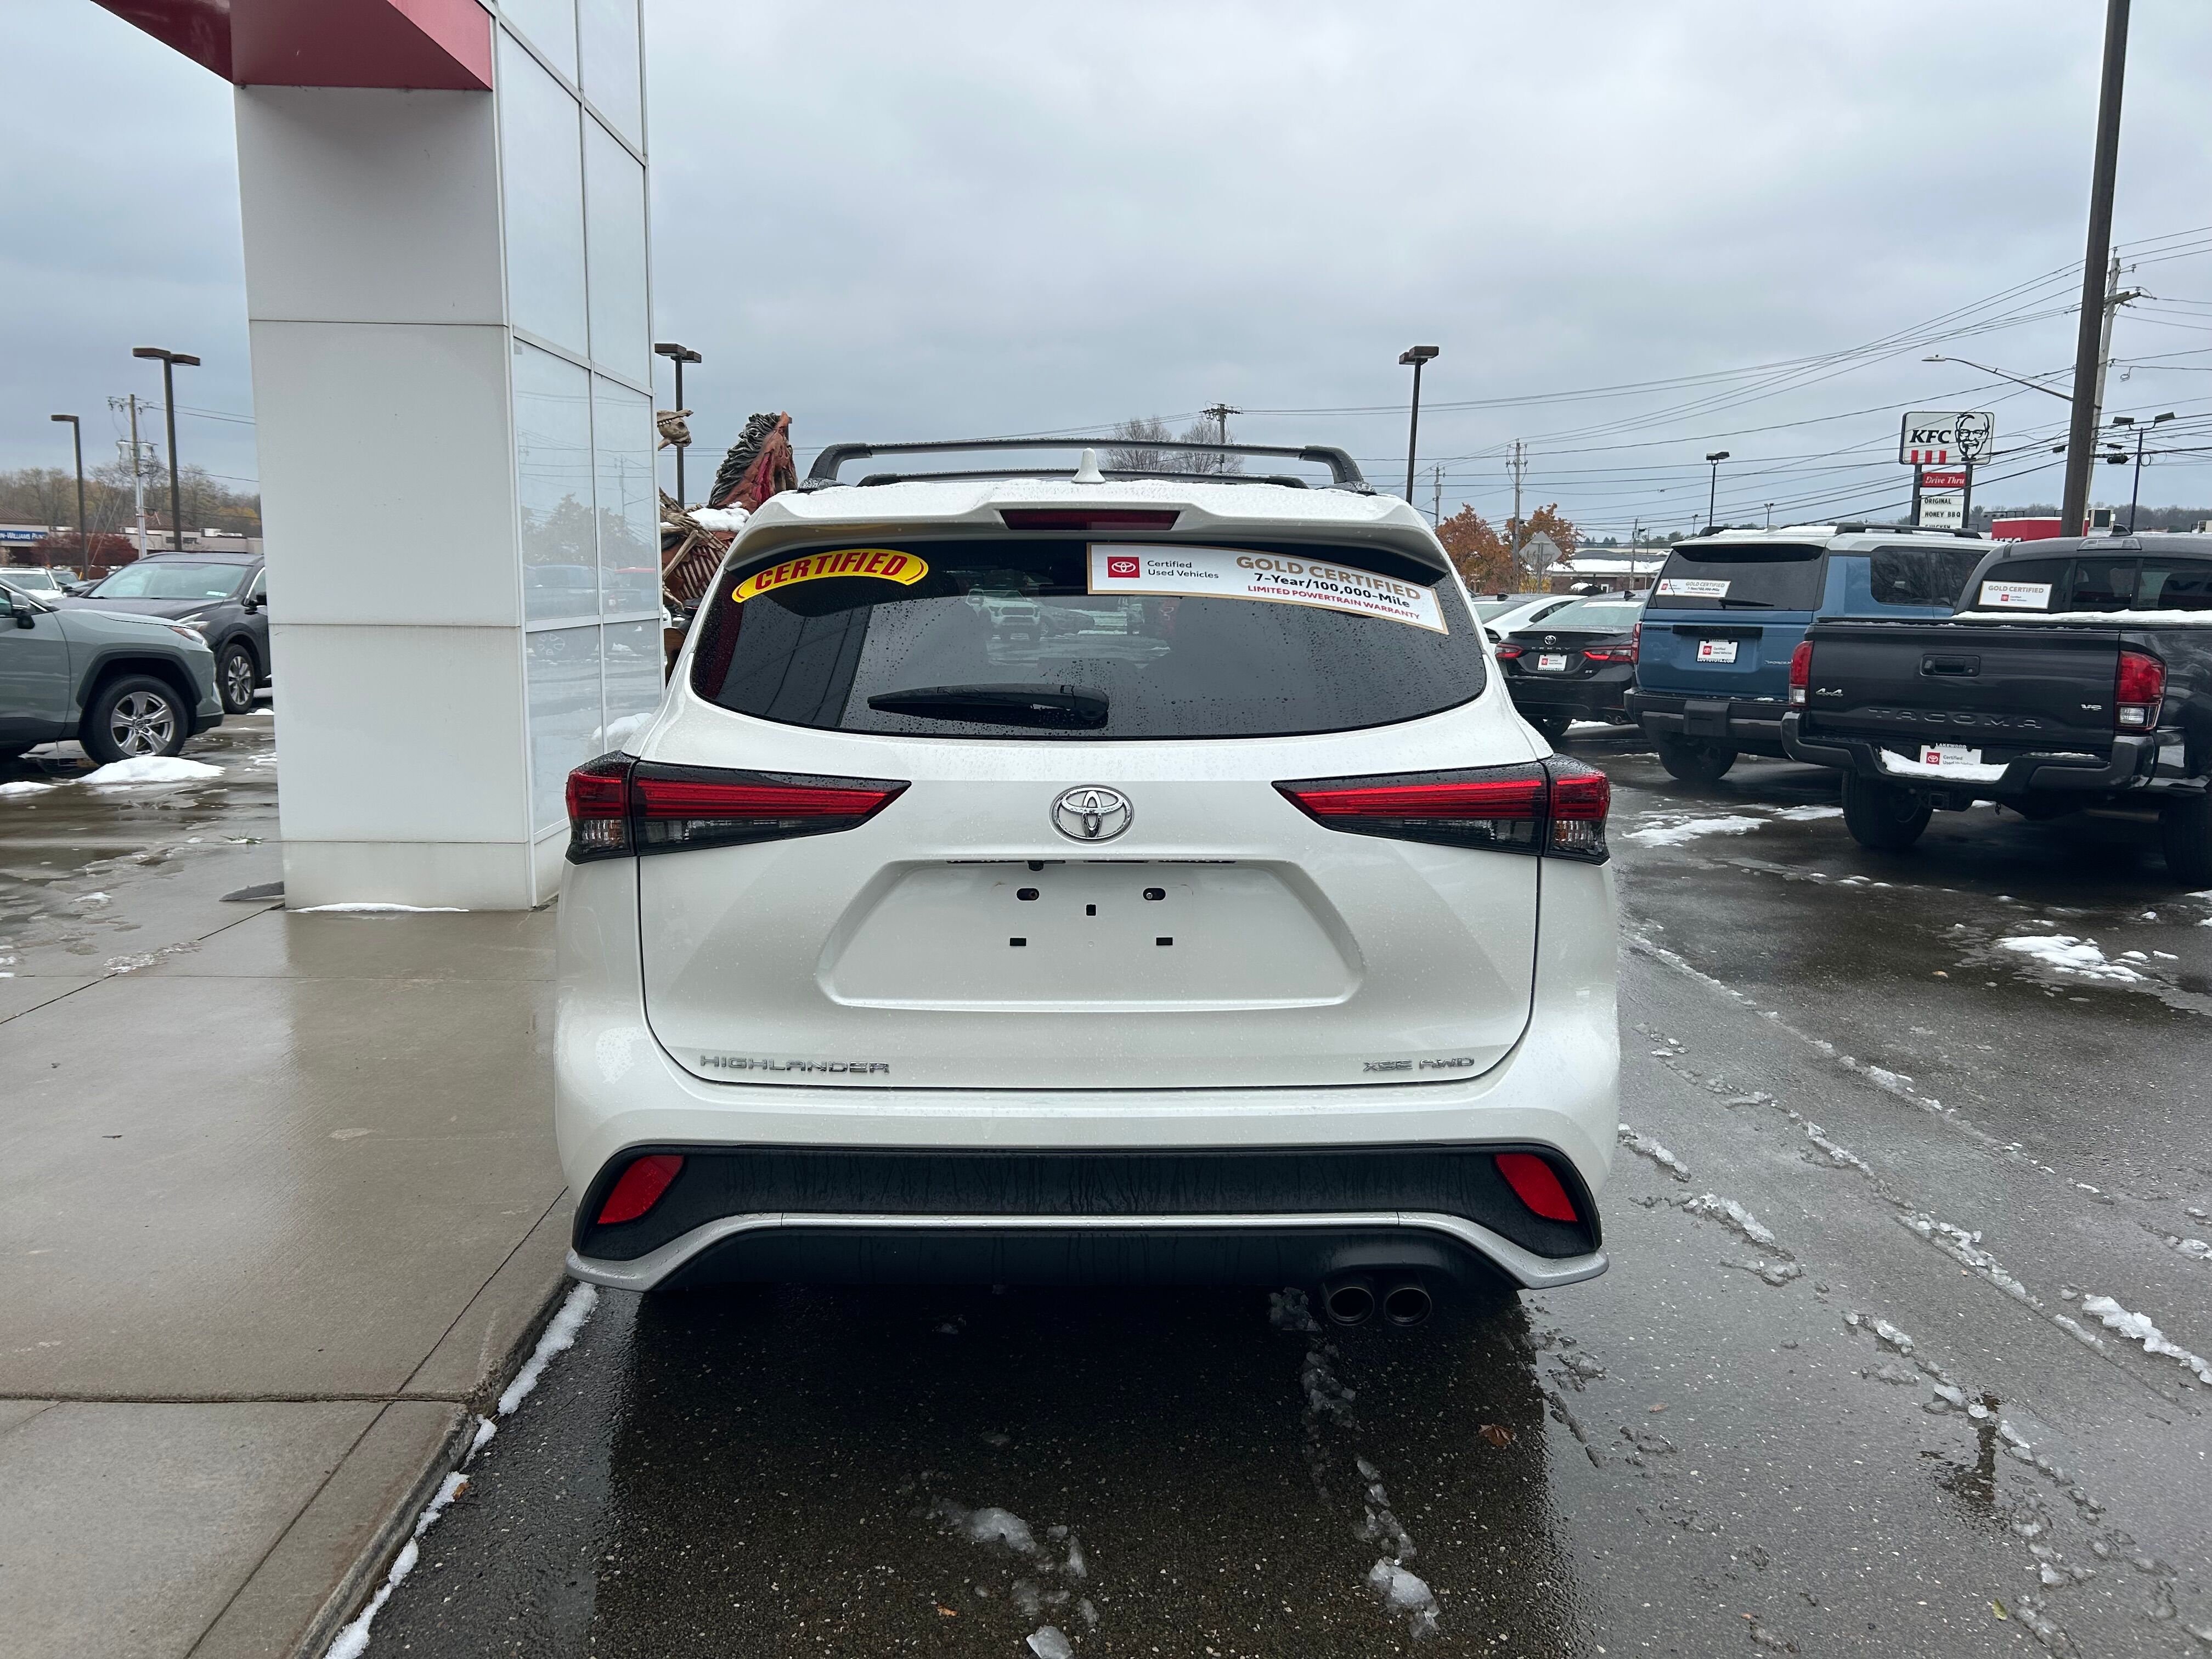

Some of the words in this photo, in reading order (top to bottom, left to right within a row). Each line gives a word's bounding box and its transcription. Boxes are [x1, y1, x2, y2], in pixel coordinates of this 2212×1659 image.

[1909, 430, 1951, 443] KFC
[1926, 476, 1945, 484] Drive
[755, 552, 908, 590] CERTIFIED
[1148, 560, 1192, 568] Certified
[1177, 571, 1219, 579] Vehicles
[1236, 556, 1304, 575] GOLD
[1309, 566, 1421, 600] CERTIFIED
[1254, 573, 1410, 608] 7-Year/100,000-Mile
[1248, 585, 1290, 595] LIMITED
[1293, 591, 1362, 606] POWERTRAIN
[1363, 601, 1420, 619] WARRANTY
[1867, 708, 2042, 729] TACOMA
[700, 1054, 890, 1073] HIGHLANDER
[1363, 1059, 1413, 1073] XSE
[1419, 1056, 1475, 1070] AWD
